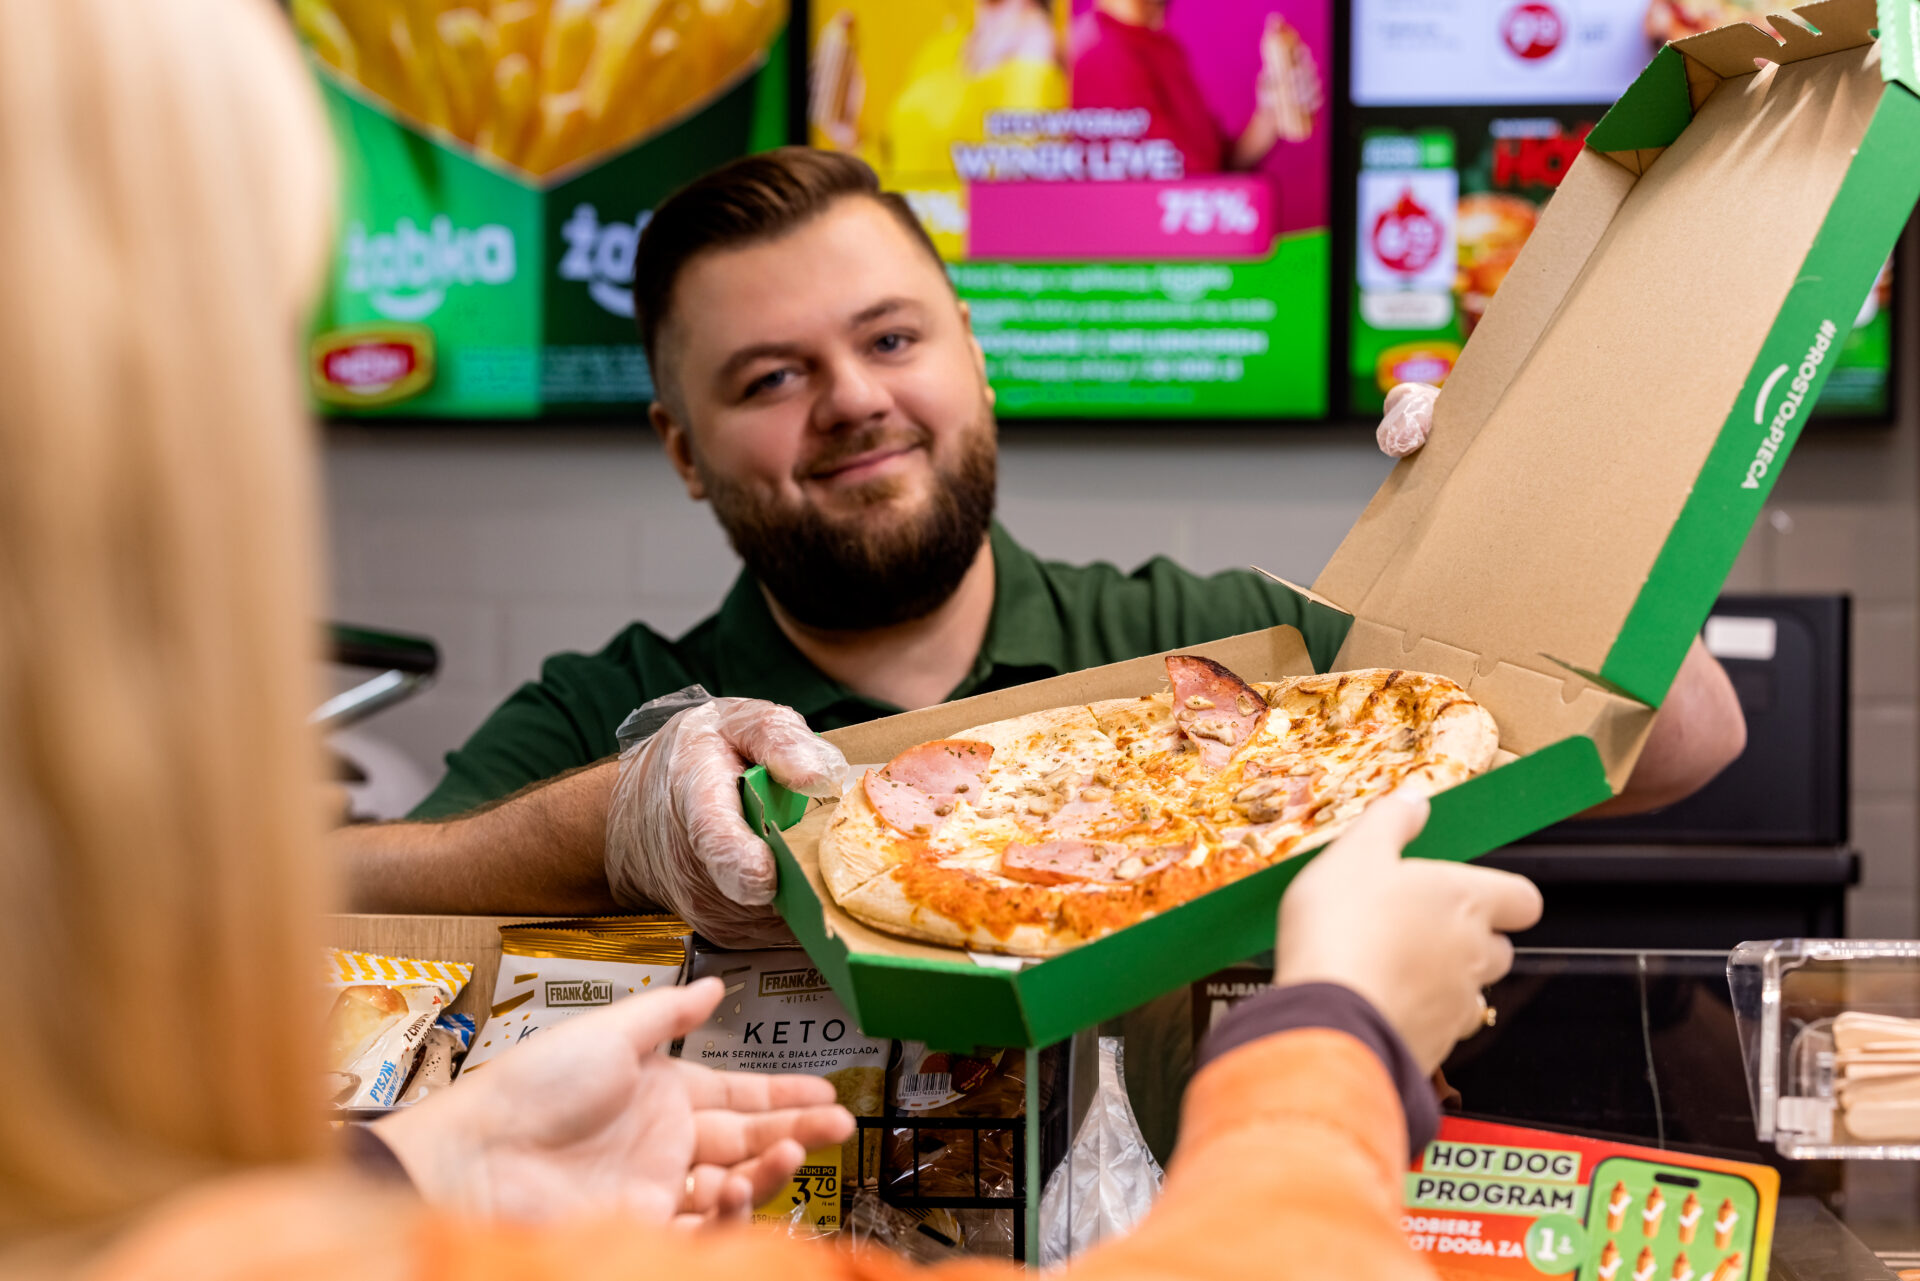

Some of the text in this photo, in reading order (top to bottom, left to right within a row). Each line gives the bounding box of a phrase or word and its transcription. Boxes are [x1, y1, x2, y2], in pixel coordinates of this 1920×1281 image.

[1159, 190, 1257, 233] 75%
[550, 981, 608, 1001] FRANK&OLI
[743, 1019, 846, 1044] KETO
[702, 1046, 879, 1059] SMAK SERNIKA & BIAŁA CZEKOLADA
[781, 1059, 838, 1069] CIASTECZKO
[1432, 1146, 1573, 1175] HOT DOG
[1416, 1178, 1574, 1208] PROGRAM
[1407, 1235, 1523, 1258] OT DOGA ZA
